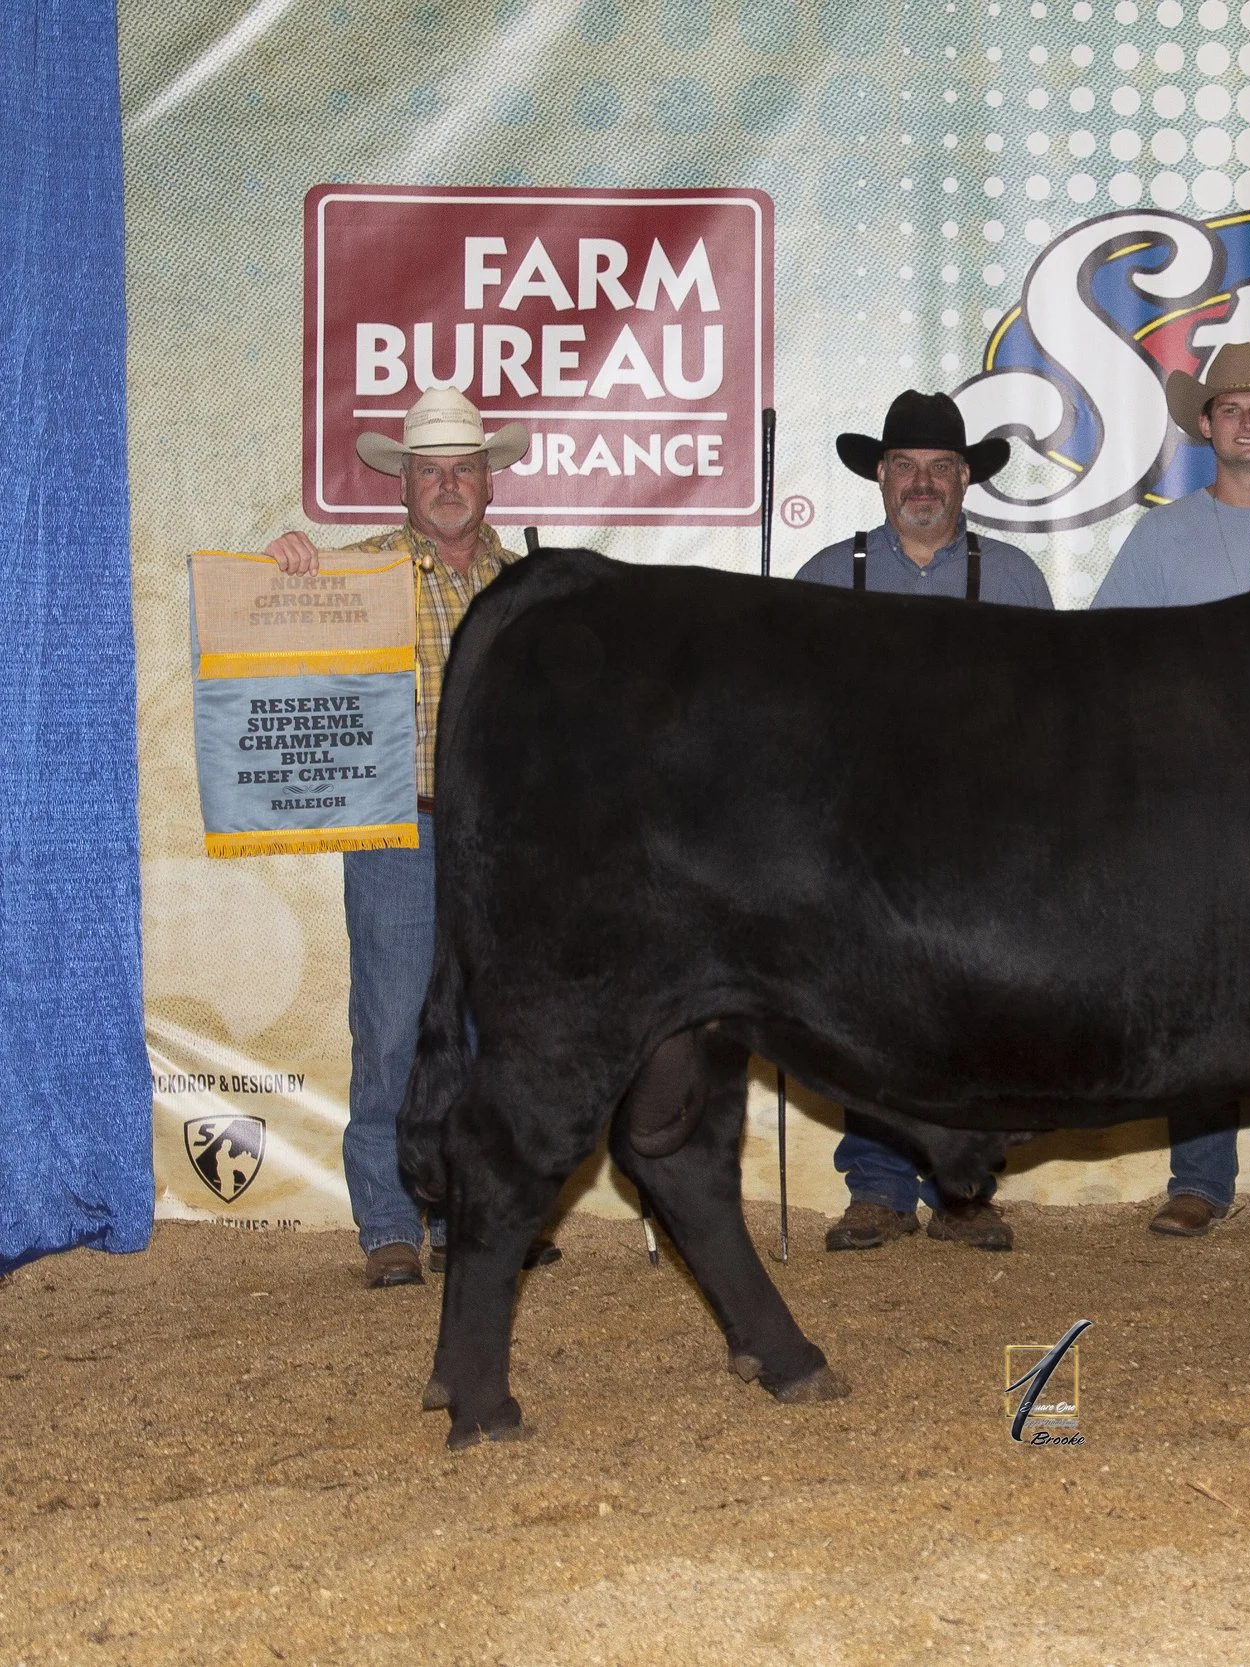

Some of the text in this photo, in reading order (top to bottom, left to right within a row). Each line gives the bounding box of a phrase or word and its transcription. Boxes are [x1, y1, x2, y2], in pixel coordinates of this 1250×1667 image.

[465, 236, 720, 312] FARM
[356, 323, 724, 400] BUREAU
[484, 433, 724, 477] URANCE
[271, 577, 346, 590] NORTH
[254, 594, 363, 609] CAROLINA
[250, 610, 369, 626] STATE FAIR
[250, 696, 360, 714] RESERVE
[247, 714, 363, 733] SUPREME
[239, 731, 373, 751] CHAMPION
[281, 751, 334, 765] BULL
[238, 766, 376, 784] BEEF CATTLE
[271, 797, 346, 810] RALEIGH
[219, 1074, 230, 1092] &
[232, 1074, 283, 1093] DESIGN
[287, 1074, 305, 1093] BY
